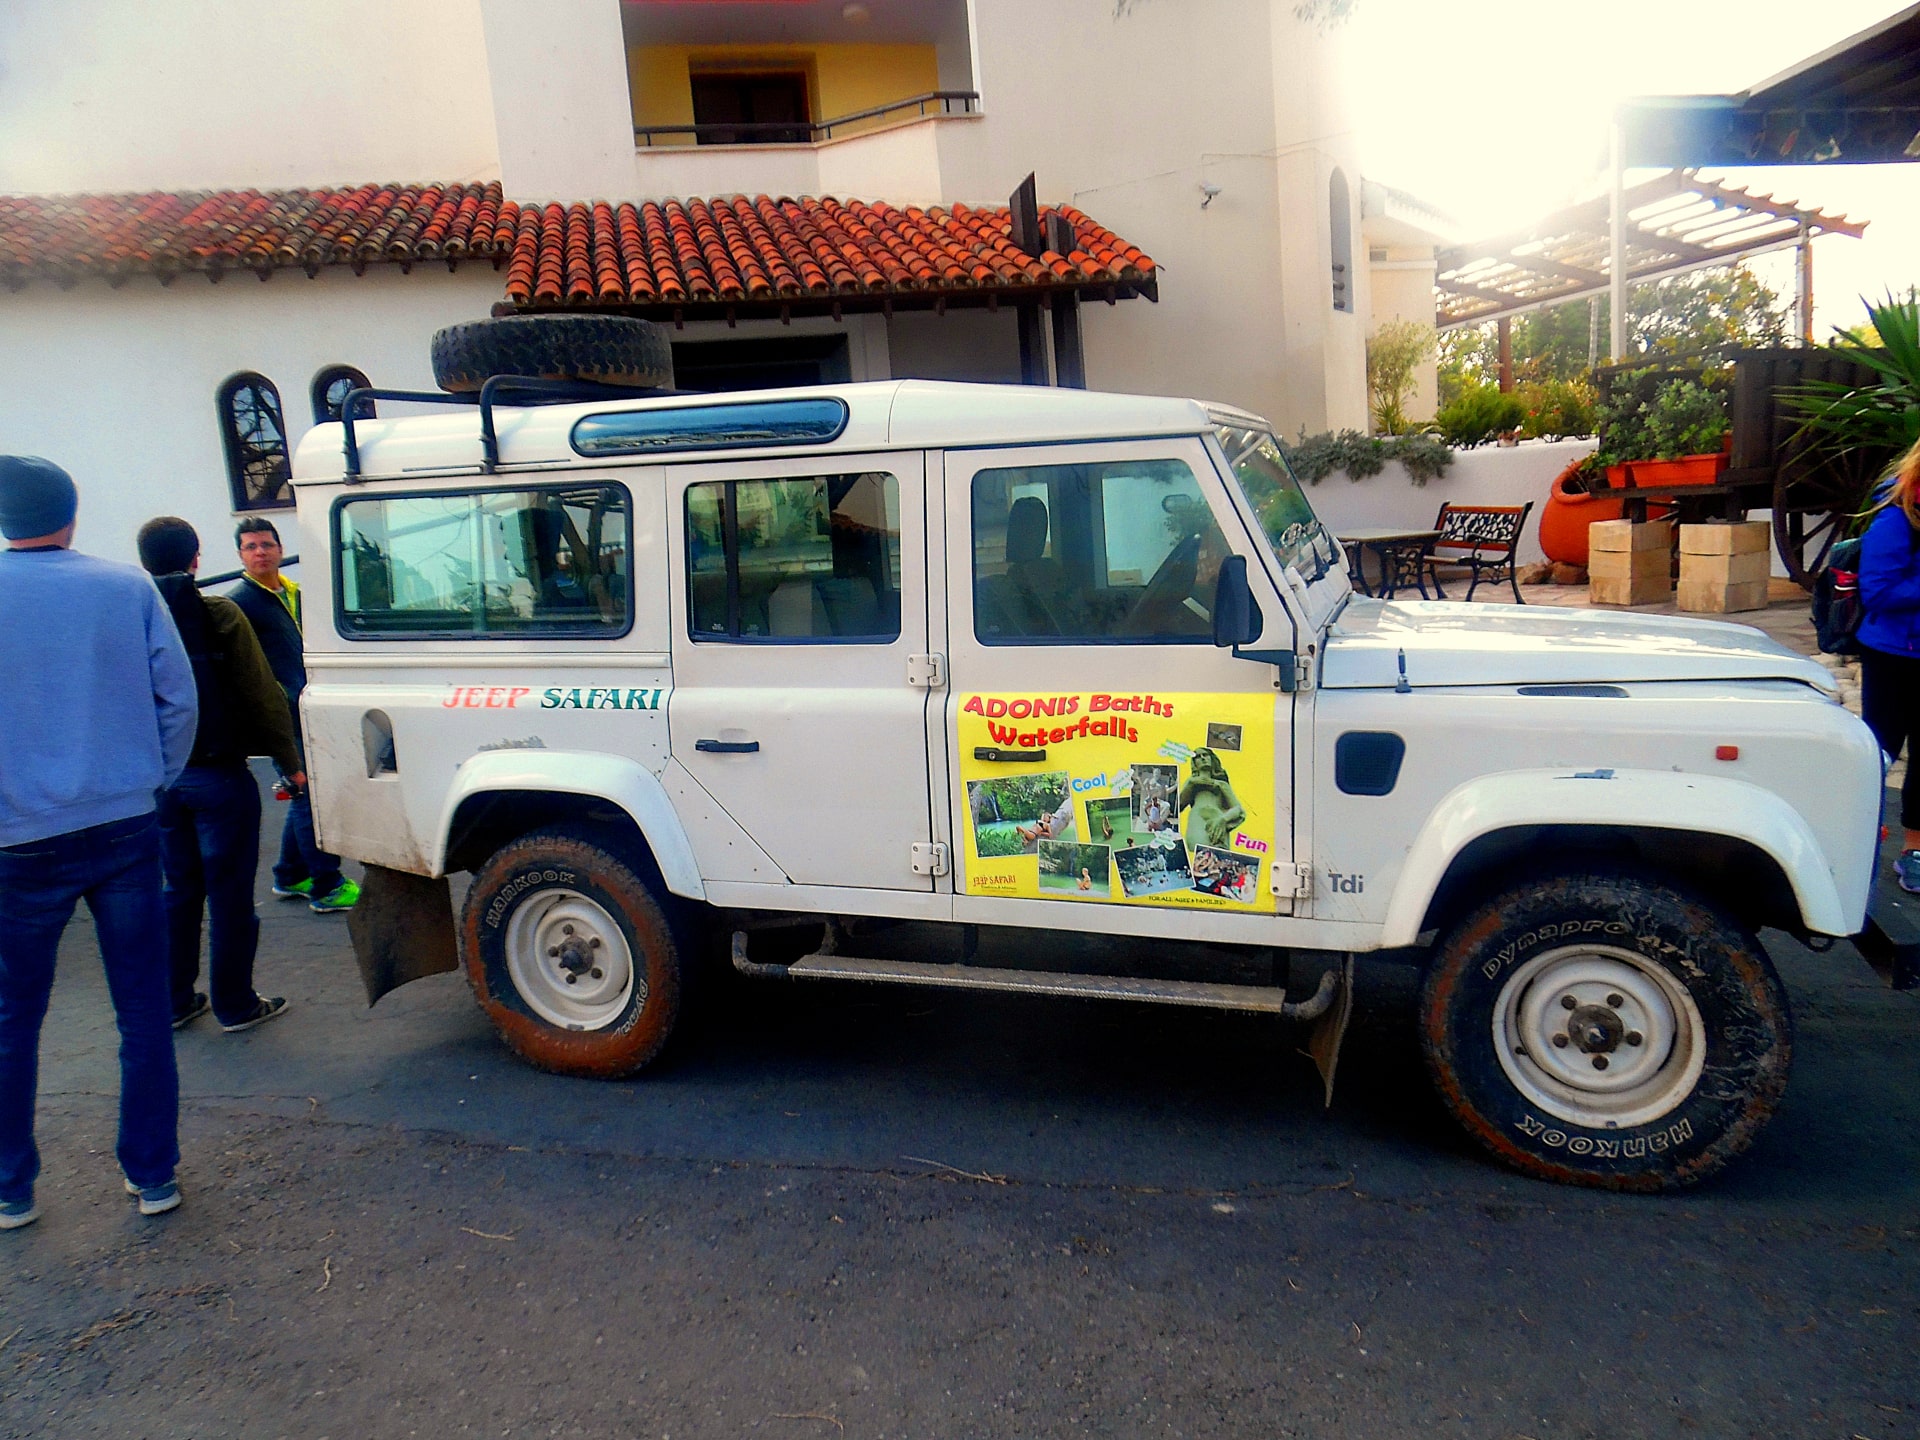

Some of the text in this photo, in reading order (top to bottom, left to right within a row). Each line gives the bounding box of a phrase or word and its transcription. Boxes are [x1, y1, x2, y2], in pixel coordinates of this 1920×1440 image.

[442, 687, 664, 710] JEEP SAFARI
[964, 694, 1174, 719] ADONIS Baths
[988, 716, 1138, 748] Waterfalls
[1072, 773, 1106, 793] Cool
[1234, 832, 1268, 853] Fun
[989, 874, 1016, 884] SAFARI
[1328, 873, 1364, 893] Tdi
